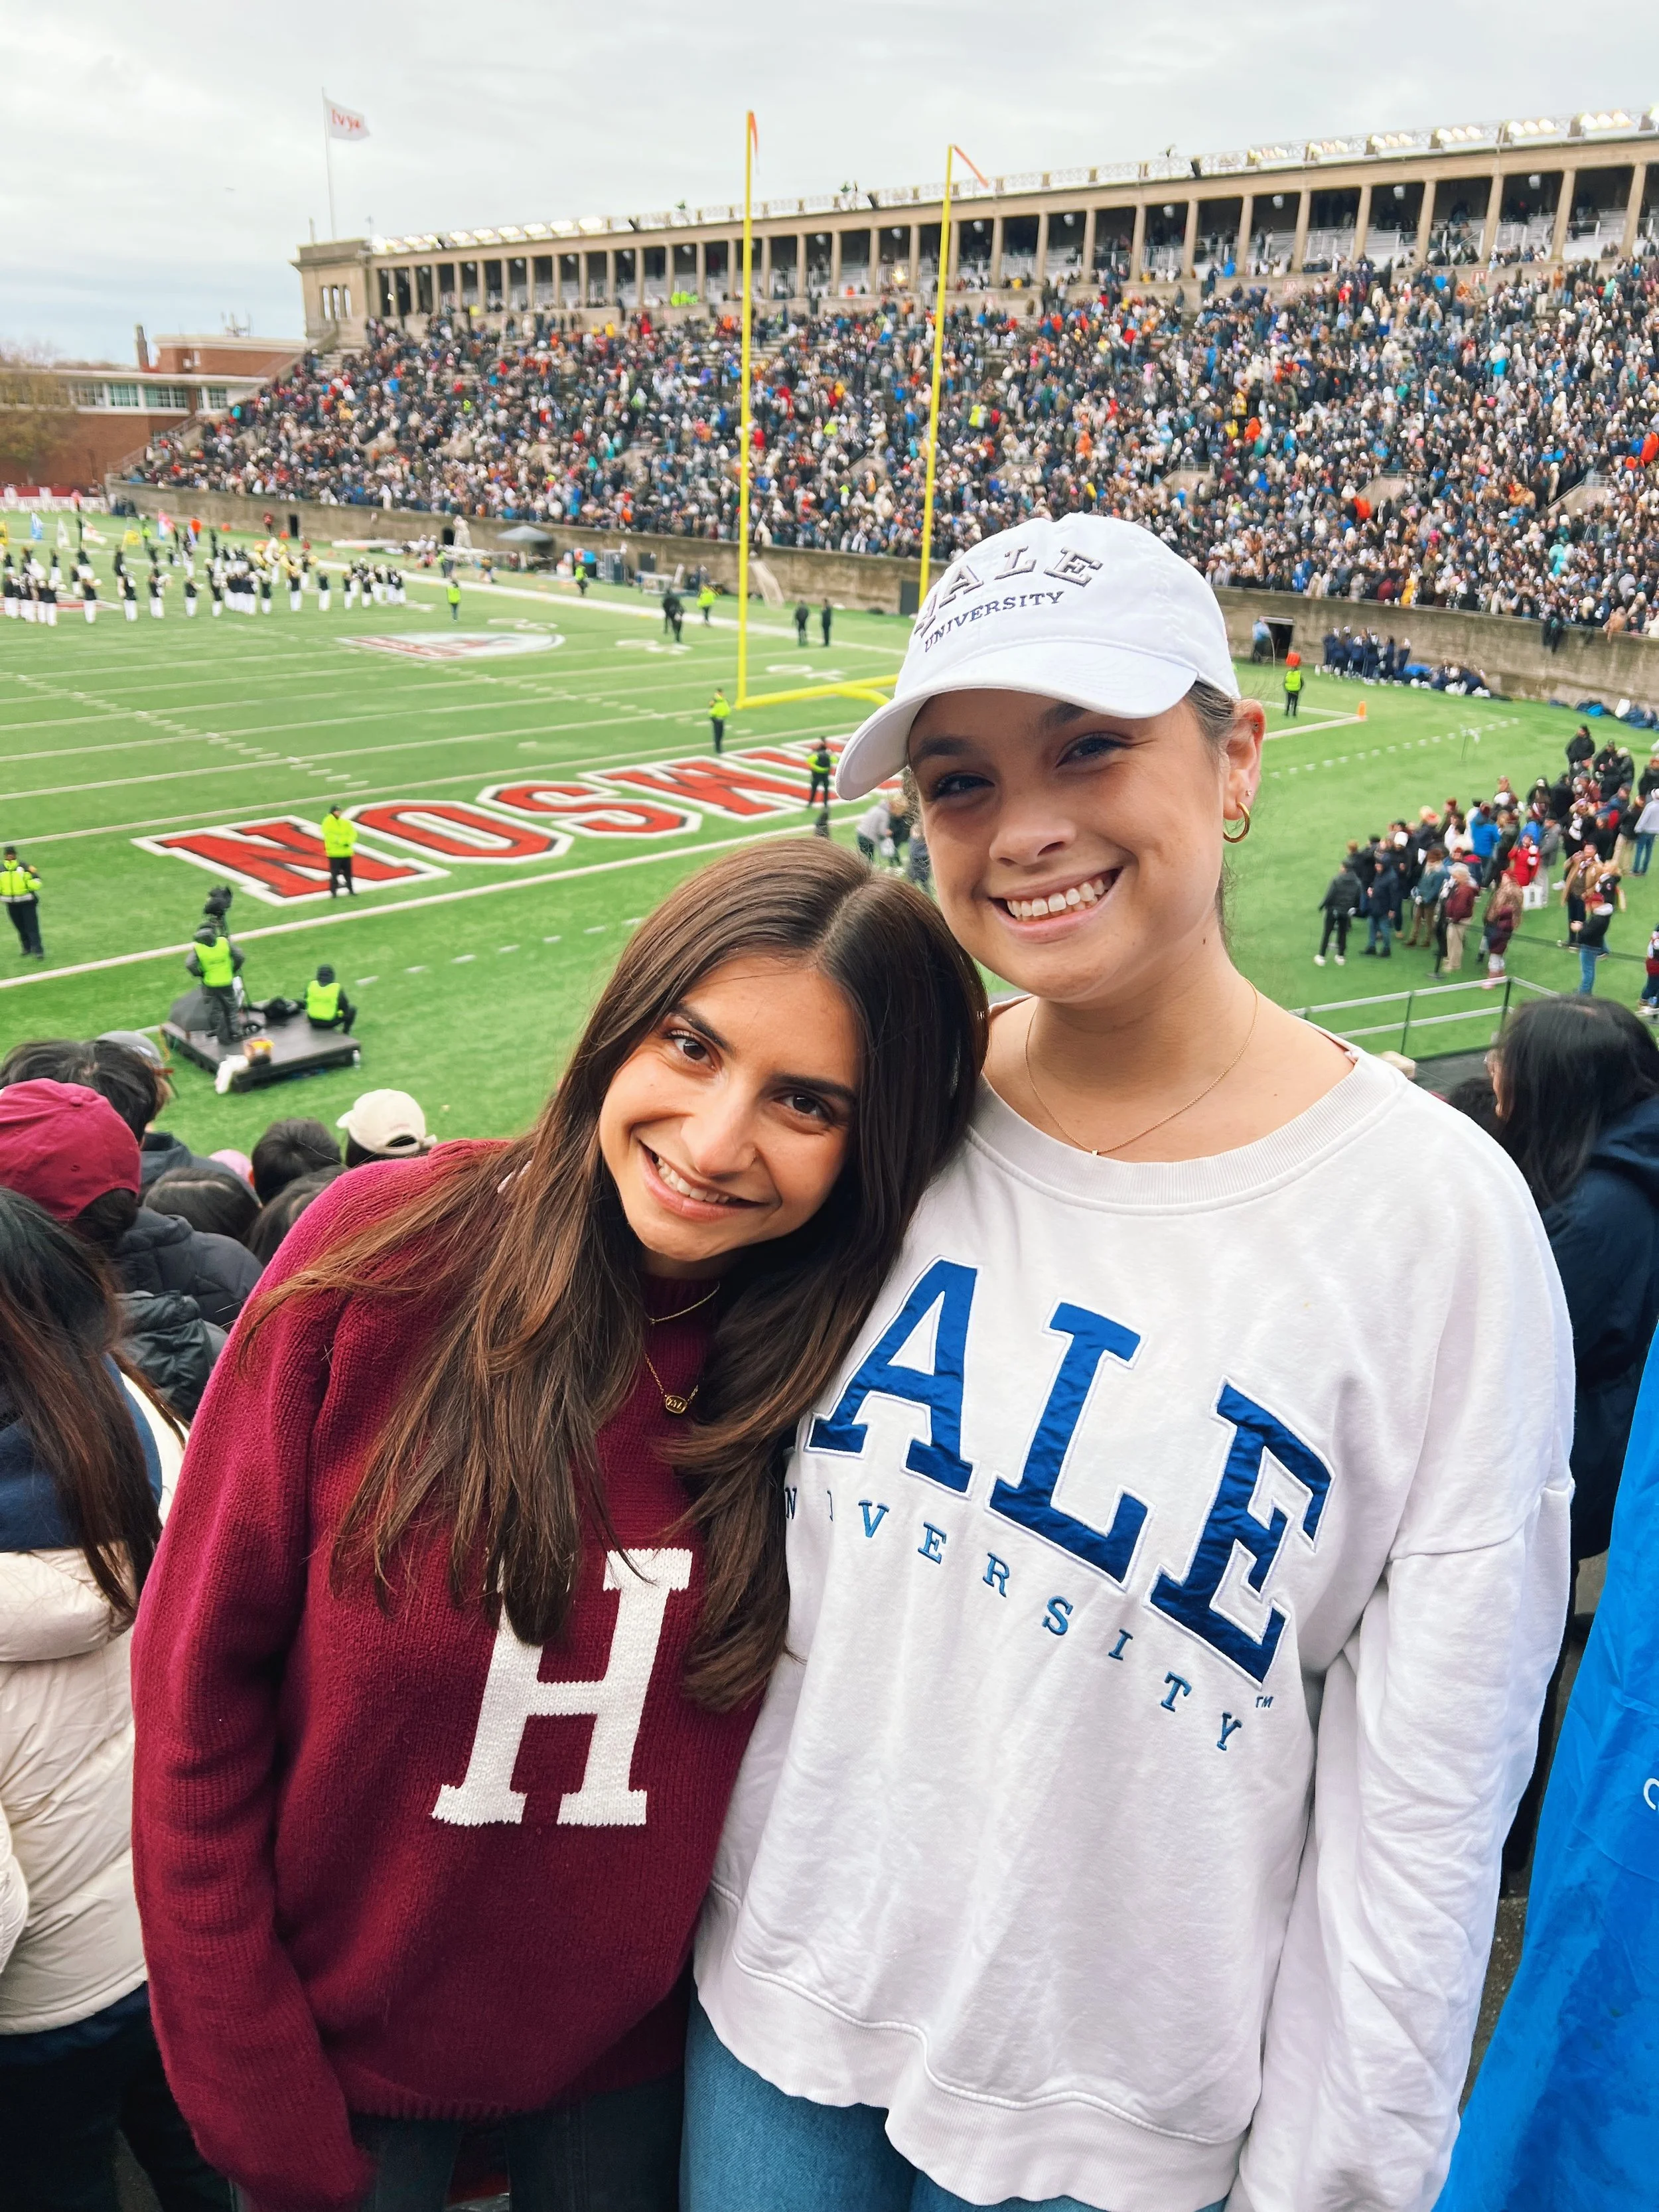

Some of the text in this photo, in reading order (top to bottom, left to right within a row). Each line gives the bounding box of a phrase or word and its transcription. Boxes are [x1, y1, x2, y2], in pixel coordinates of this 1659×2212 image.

[924, 591, 1064, 653] UNIVERSITY
[804, 1254, 1336, 1690] ALE
[432, 1547, 693, 1826] H
[784, 1486, 1242, 1751] NIVERSITY
[1256, 1696, 1273, 1708] TM
